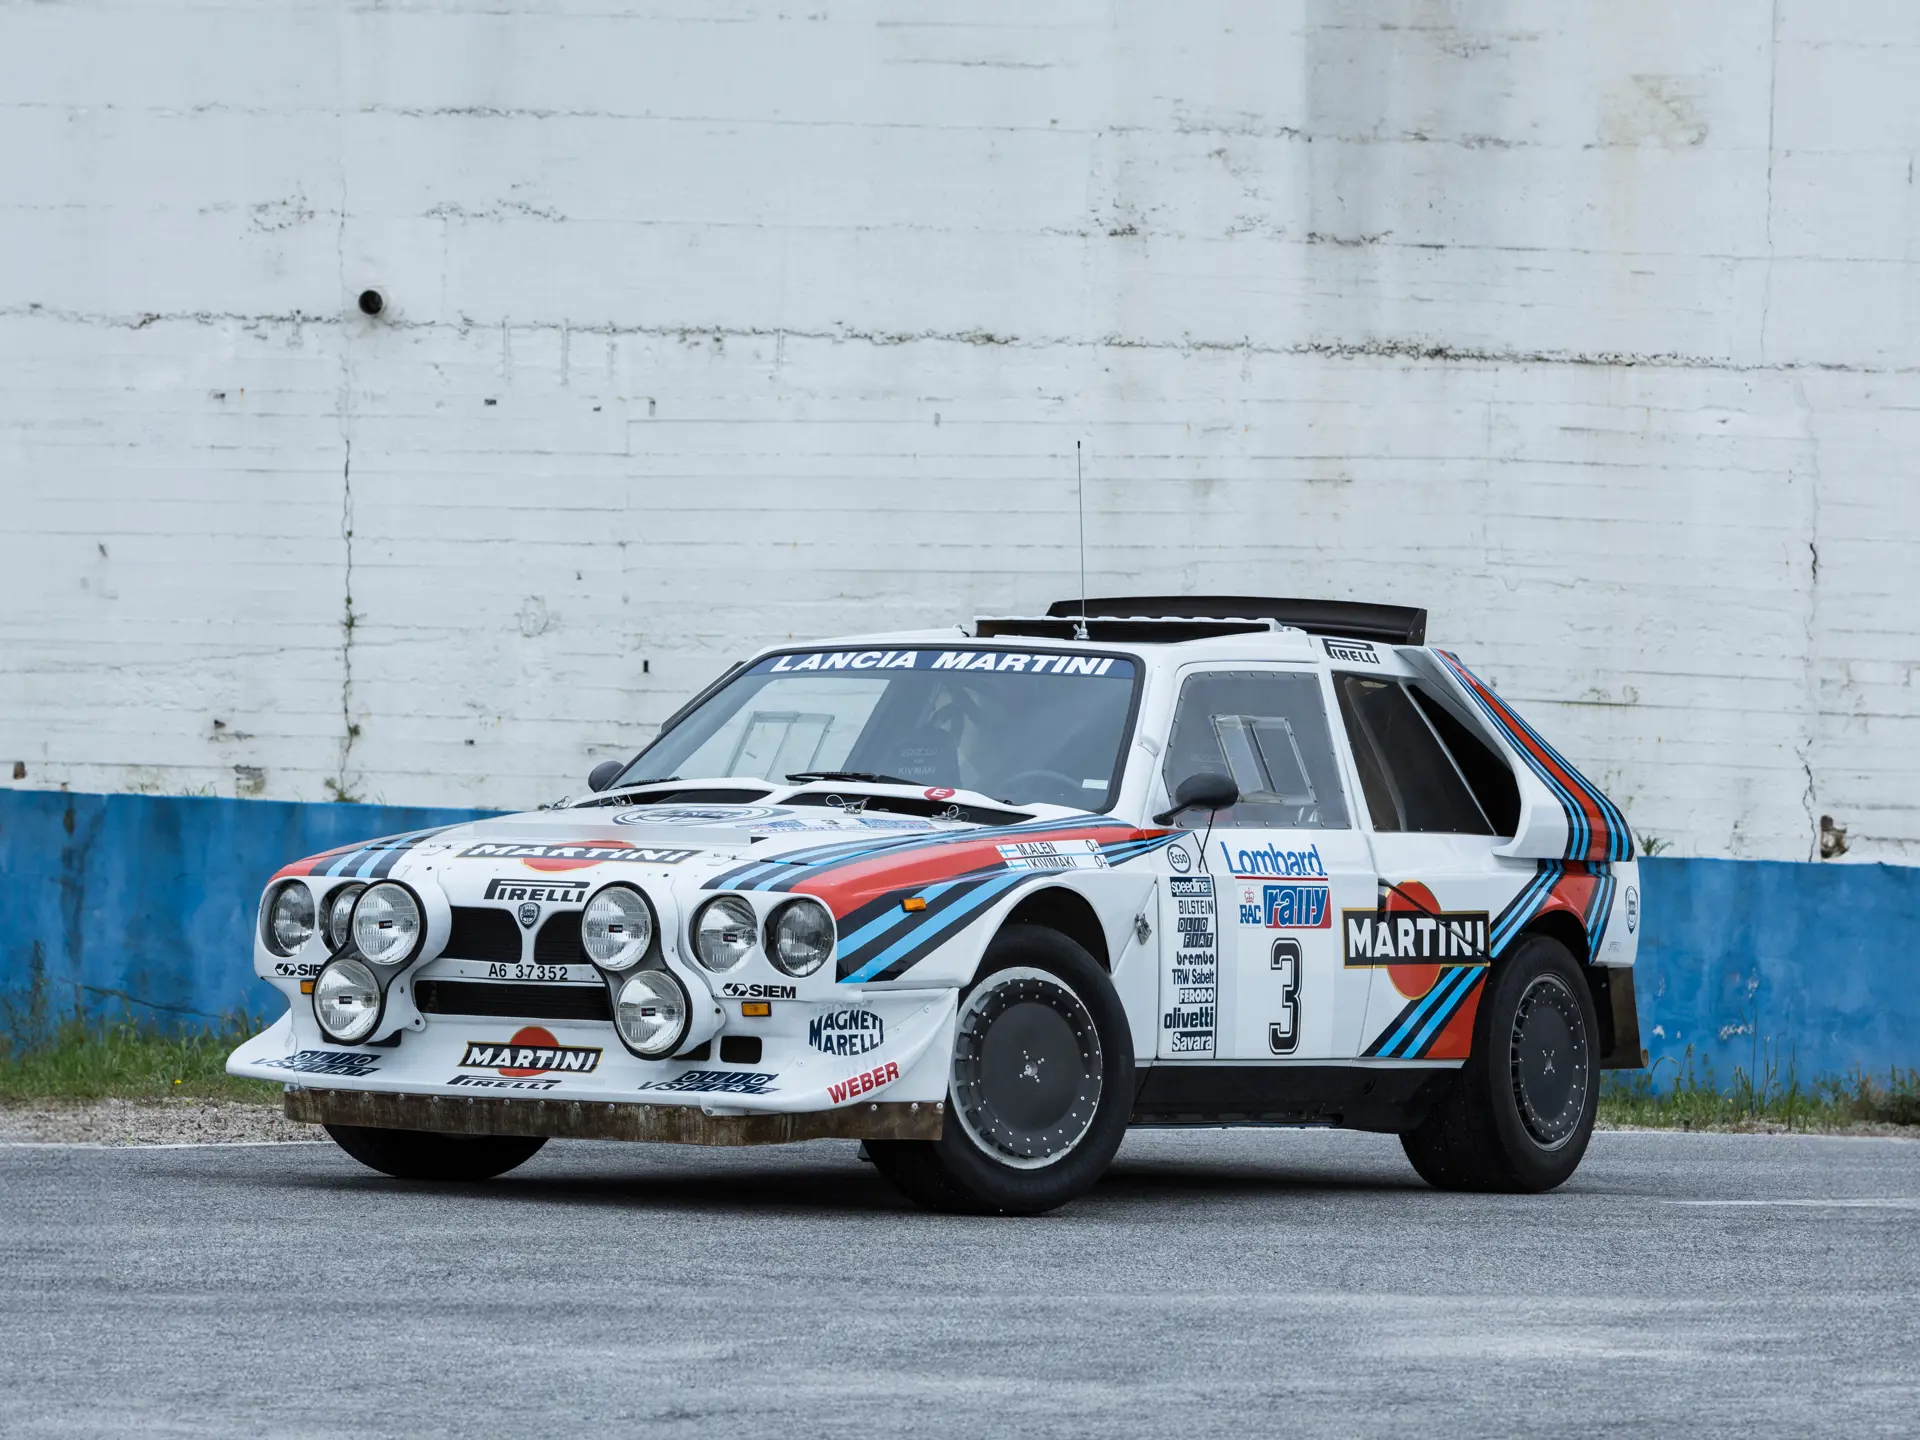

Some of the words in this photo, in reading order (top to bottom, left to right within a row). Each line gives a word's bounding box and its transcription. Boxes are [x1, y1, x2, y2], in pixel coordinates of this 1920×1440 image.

[1321, 638, 1381, 664] PIRELLI
[770, 651, 918, 672] LANCIA
[931, 652, 1115, 676] MARTINI
[930, 789, 950, 798] E
[468, 844, 692, 861] MARTINI
[1016, 842, 1057, 855] M.ALEN
[1170, 851, 1188, 864] Esso
[1219, 841, 1328, 876] Lombard
[483, 878, 591, 902] PIRELLI
[1171, 878, 1208, 896] speedline
[1178, 900, 1214, 915] BILSTEIN
[1239, 904, 1262, 924] RAC
[1265, 888, 1329, 926] rally
[1178, 918, 1208, 932] OLIO
[1184, 933, 1214, 947] FIAT
[1348, 917, 1486, 958] MARTINI
[1176, 951, 1215, 966] brembo
[297, 963, 323, 977] SIE
[488, 963, 507, 978] A6
[515, 964, 568, 981] 37352
[1172, 969, 1190, 985] TRW
[1191, 969, 1215, 985] Sabelt
[748, 984, 797, 998] SIEM
[1179, 988, 1214, 1003] FERODO
[1268, 937, 1303, 1055] 3
[808, 1009, 884, 1040] MAGNETI
[1164, 1006, 1214, 1029] olivetti
[1172, 1032, 1213, 1051] Savara
[292, 1051, 376, 1065] OLIO
[465, 1047, 597, 1071] MARTINI
[446, 1074, 563, 1091] PIRELLI
[681, 1071, 771, 1085] OLIO
[826, 1061, 900, 1105] WEBER
